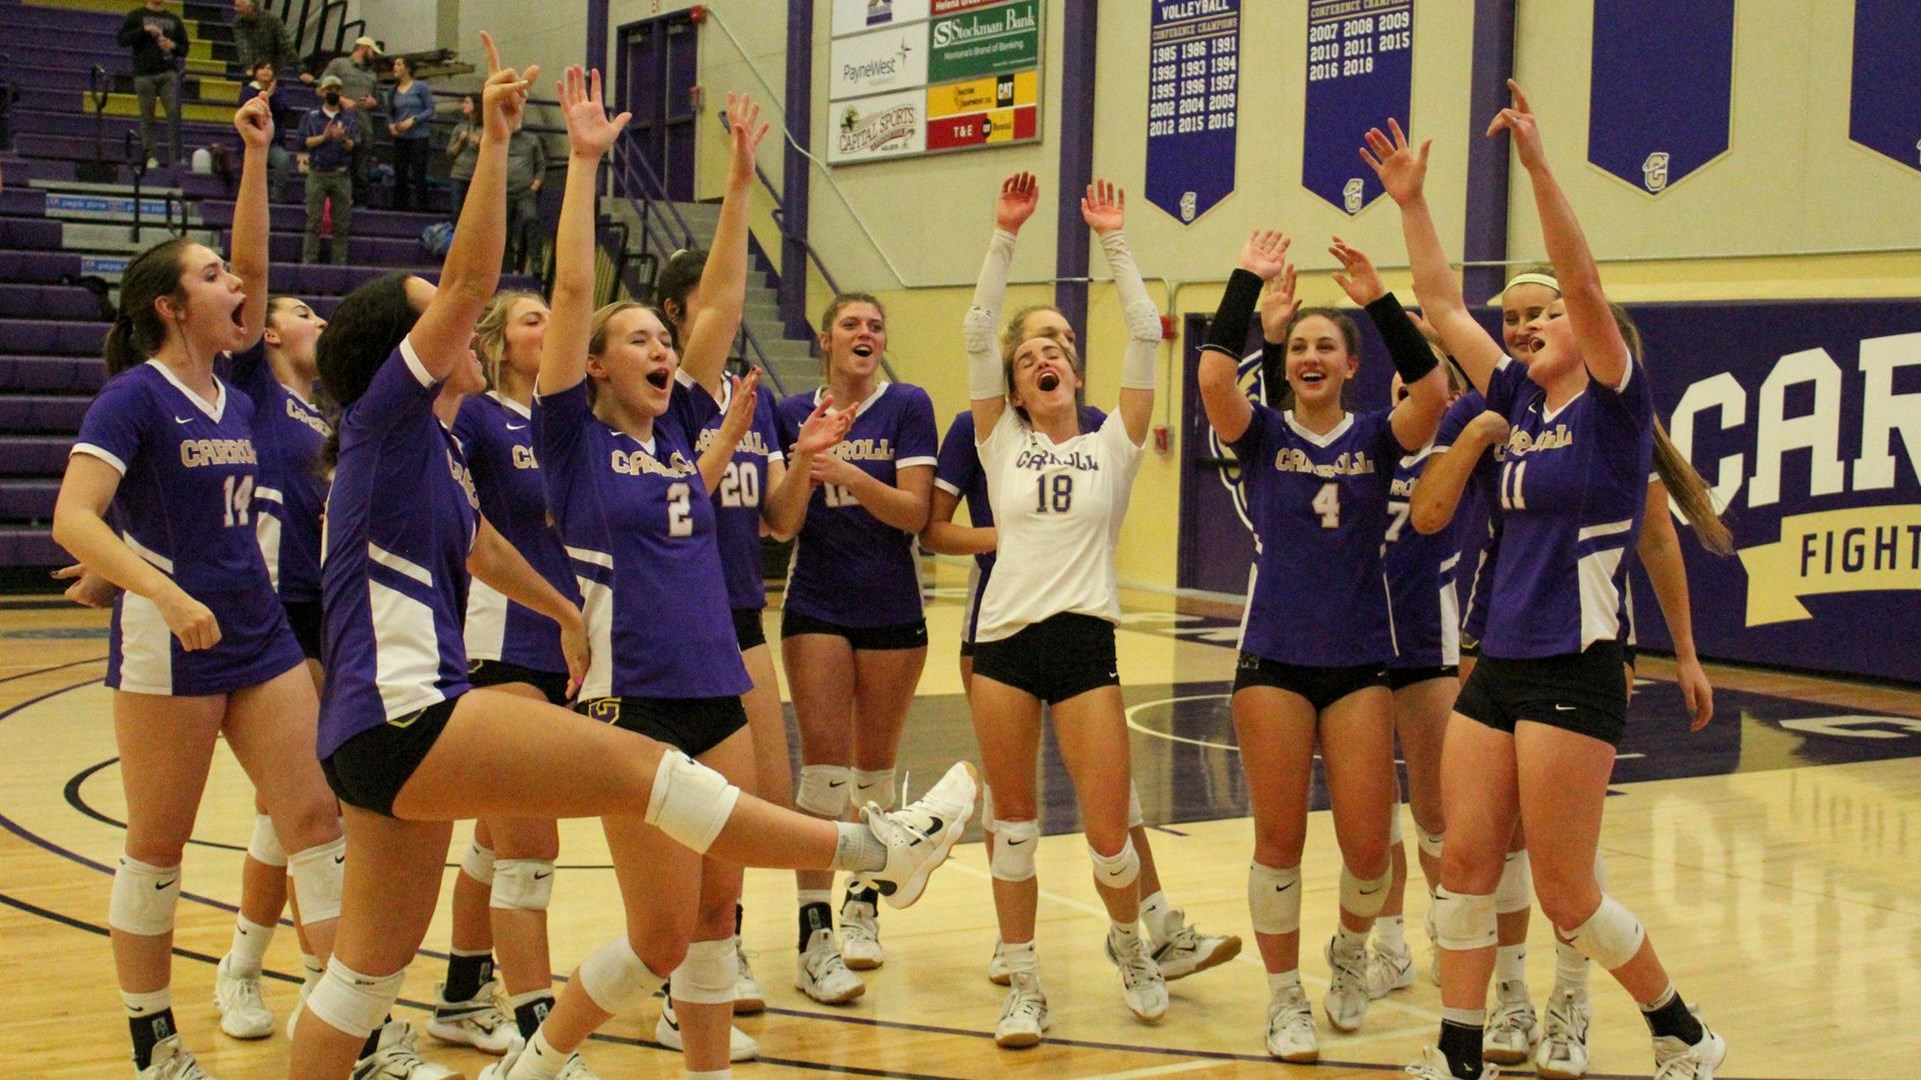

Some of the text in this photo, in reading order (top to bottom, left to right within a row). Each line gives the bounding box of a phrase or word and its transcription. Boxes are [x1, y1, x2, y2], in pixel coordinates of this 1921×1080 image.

[951, 16, 1004, 41] Stockman
[1005, 5, 1036, 31] Bank
[1162, 0, 1229, 20] VOLLEYBALL
[1310, 11, 1410, 43] 2007 2008 2009
[1211, 36, 1236, 55] 1991
[1310, 31, 1410, 62] 2010 2011 2015
[843, 57, 896, 83] PayneWest
[1152, 55, 1236, 82] 1992 1993 1994
[1309, 57, 1373, 81] 2016 2018
[997, 81, 1014, 100] CAT
[1152, 74, 1236, 100] 1995 1996 1997
[1150, 93, 1236, 118] 2002 2004 2009
[839, 122, 877, 152] CAPITAL
[880, 107, 914, 133] SPORTS
[1150, 112, 1235, 137] 2012 2015 2016
[720, 461, 760, 508] 20
[1036, 473, 1073, 514] 18
[1501, 461, 1526, 509] 11
[223, 475, 253, 527] 14
[667, 482, 693, 537] 2
[1312, 482, 1341, 529] 4
[1801, 525, 1921, 577] FIGHT
